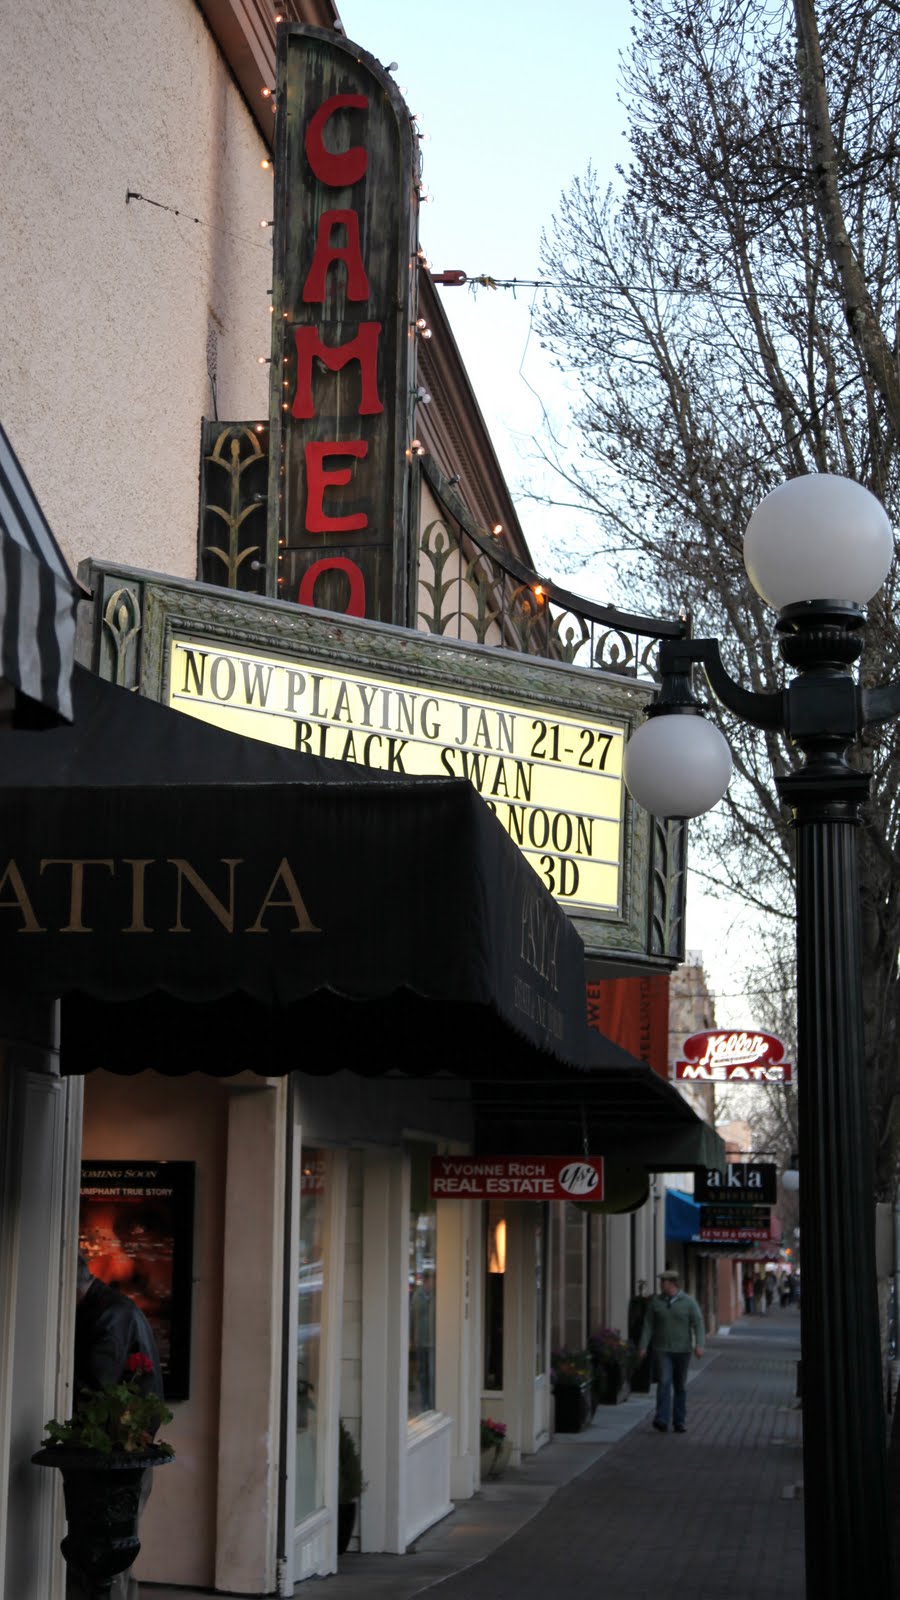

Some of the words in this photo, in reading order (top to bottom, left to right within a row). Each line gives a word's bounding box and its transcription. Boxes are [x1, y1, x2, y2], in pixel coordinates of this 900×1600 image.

[291, 93, 384, 618] CAMEO
[182, 650, 275, 707] NOW
[284, 674, 441, 741] PLAYING
[454, 703, 516, 754] JAN
[531, 720, 614, 770] 21-27
[440, 747, 534, 802] SWAN
[507, 804, 594, 856] NOON
[539, 855, 580, 897] 3D
[699, 1032, 769, 1066] Keller
[124, 1168, 158, 1179] SOON
[433, 1178, 482, 1193] REAL
[485, 1178, 555, 1193] ESTATE
[442, 1163, 504, 1176] YVONNE
[508, 1163, 546, 1176] RICH
[122, 1187, 144, 1196] TRUE
[145, 1187, 174, 1197] STORY
